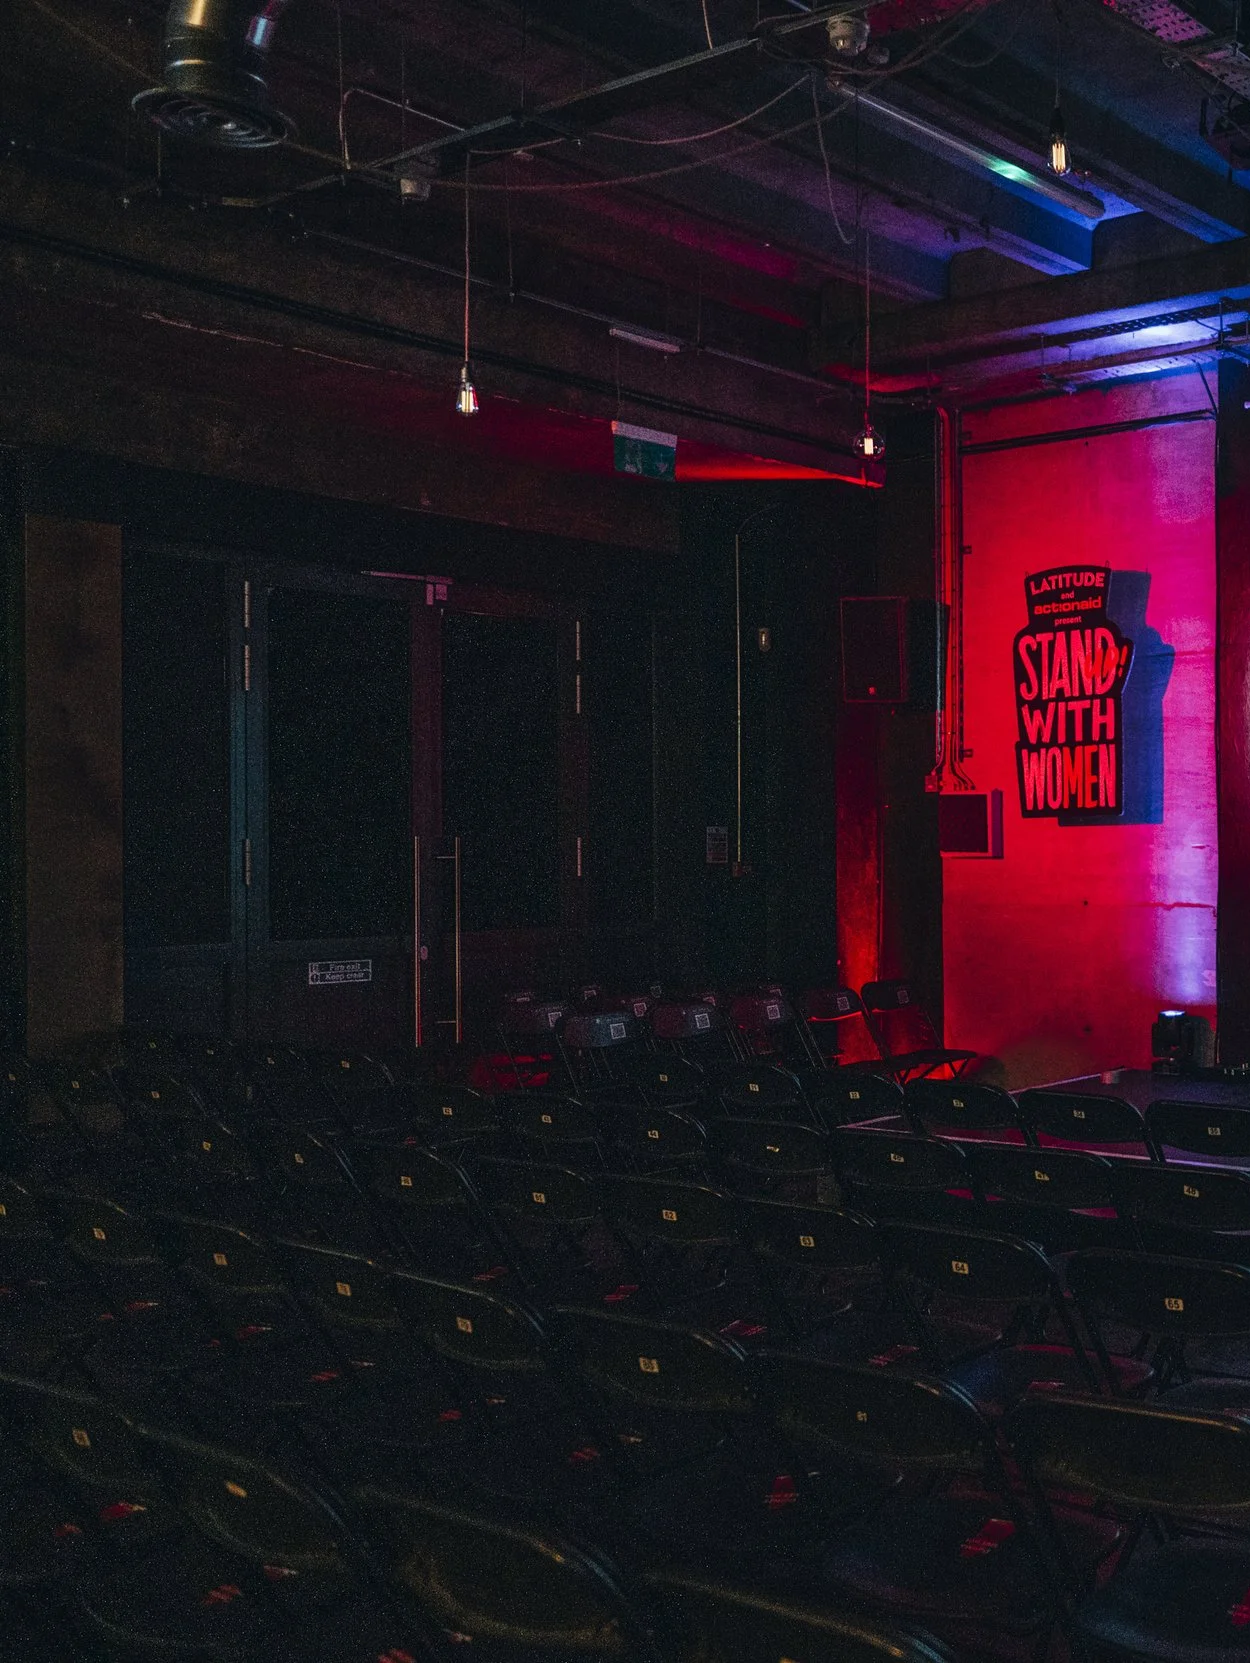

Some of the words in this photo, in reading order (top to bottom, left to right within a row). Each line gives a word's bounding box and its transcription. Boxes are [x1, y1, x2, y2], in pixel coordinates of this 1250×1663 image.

[1029, 571, 1105, 596] LATITUDE
[1060, 589, 1075, 600] and
[1054, 615, 1082, 627] present
[1018, 626, 1117, 701] STAND
[1020, 697, 1116, 745] WITH
[1021, 743, 1117, 811] WOMEN
